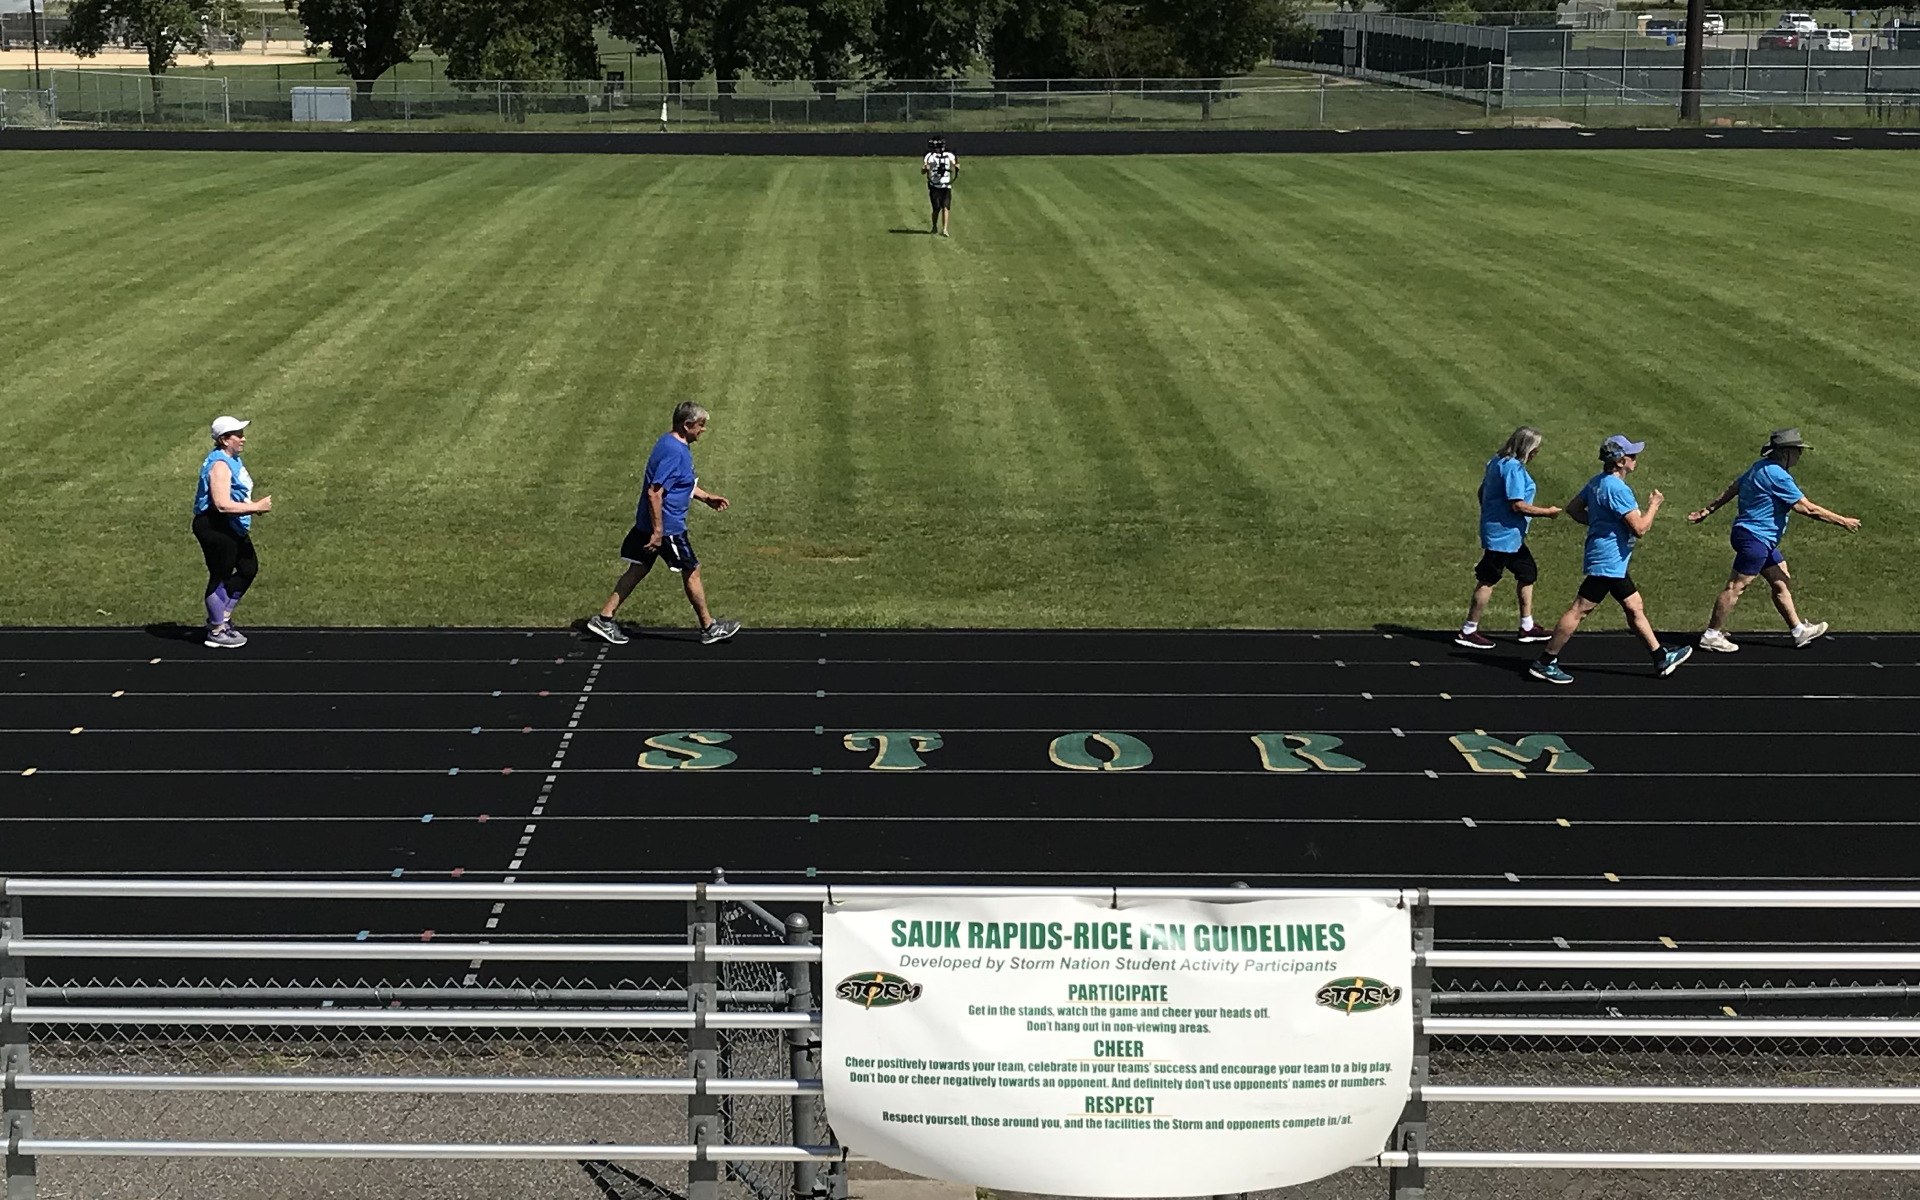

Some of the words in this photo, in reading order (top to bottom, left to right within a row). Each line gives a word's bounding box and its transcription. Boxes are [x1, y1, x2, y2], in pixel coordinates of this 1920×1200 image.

[637, 729, 1593, 773] STORM
[891, 919, 961, 948] SAUK
[967, 921, 1133, 950] RAPIDS-RICE
[1140, 922, 1186, 951] FAN
[1193, 922, 1346, 952] GUIDELINES
[899, 954, 981, 971] Developed
[986, 956, 1004, 972] by
[1010, 956, 1054, 970] Storm
[1060, 957, 1110, 970] Nation
[1115, 957, 1176, 971] Student
[1180, 958, 1239, 975] Activity
[1244, 958, 1338, 975] Participants
[836, 981, 923, 1001] STORM
[1068, 983, 1168, 1002] PARTICIPATE
[1315, 985, 1403, 1006] STORM
[969, 1005, 985, 1015] Get
[988, 1005, 997, 1015] in
[1000, 1006, 1016, 1015] the
[1019, 1006, 1055, 1017] stands,
[1058, 1007, 1088, 1016] watch
[1091, 1007, 1107, 1016] the
[1110, 1008, 1137, 1019] game
[1141, 1007, 1160, 1017] and
[1162, 1007, 1191, 1018] cheer
[1194, 1009, 1217, 1020] your
[1220, 1007, 1251, 1018] heads
[1254, 1007, 1270, 1018] off.
[1027, 1021, 1052, 1031] Don't
[1055, 1022, 1079, 1033] hang
[1083, 1022, 1099, 1031] out
[1102, 1022, 1111, 1031] in
[1114, 1023, 1176, 1034] non-viewing
[1179, 1024, 1210, 1034] areas.
[1094, 1040, 1144, 1057] CHEER
[845, 1057, 874, 1068] Cheer
[878, 1059, 927, 1070] positively
[929, 1060, 970, 1071] towards
[973, 1062, 994, 1072] your
[998, 1062, 1025, 1073] team,
[1028, 1062, 1077, 1072] celebrate
[1080, 1063, 1089, 1072] in
[1092, 1064, 1115, 1073] your
[1118, 1063, 1151, 1073] teams'
[1154, 1064, 1197, 1074] success
[1200, 1064, 1218, 1074] and
[1221, 1064, 1276, 1075] encourage
[1279, 1064, 1301, 1074] your
[1304, 1064, 1329, 1073] team
[1331, 1063, 1341, 1073] to
[1343, 1064, 1349, 1073] a
[1352, 1062, 1367, 1073] big
[1370, 1062, 1392, 1073] play.
[850, 1073, 875, 1083] Don't
[878, 1074, 896, 1083] boo
[899, 1075, 909, 1084] or
[912, 1074, 940, 1084] cheer
[943, 1075, 996, 1087] negatively
[999, 1077, 1040, 1087] towards
[1043, 1078, 1055, 1087] an
[1058, 1078, 1109, 1089] opponent.
[1112, 1078, 1130, 1088] And
[1134, 1078, 1182, 1090] definitely
[1185, 1078, 1210, 1089] don't
[1213, 1080, 1231, 1089] use
[1234, 1079, 1290, 1090] opponents'
[1293, 1079, 1325, 1088] names
[1328, 1078, 1338, 1087] or
[1341, 1077, 1386, 1087] numbers.
[1086, 1097, 1154, 1113] RESPECT
[883, 1112, 923, 1123] Respect
[926, 1115, 969, 1126] yourself,
[971, 1117, 999, 1127] those
[1003, 1117, 1038, 1128] around
[1041, 1119, 1062, 1129] you,
[1064, 1118, 1083, 1128] and
[1086, 1118, 1102, 1128] the
[1105, 1119, 1150, 1129] facilities
[1153, 1119, 1169, 1129] the
[1172, 1119, 1202, 1129] Storm
[1205, 1119, 1224, 1129] and
[1227, 1119, 1280, 1130] opponents
[1283, 1117, 1325, 1128] compete
[1328, 1116, 1352, 1126] in/at.
